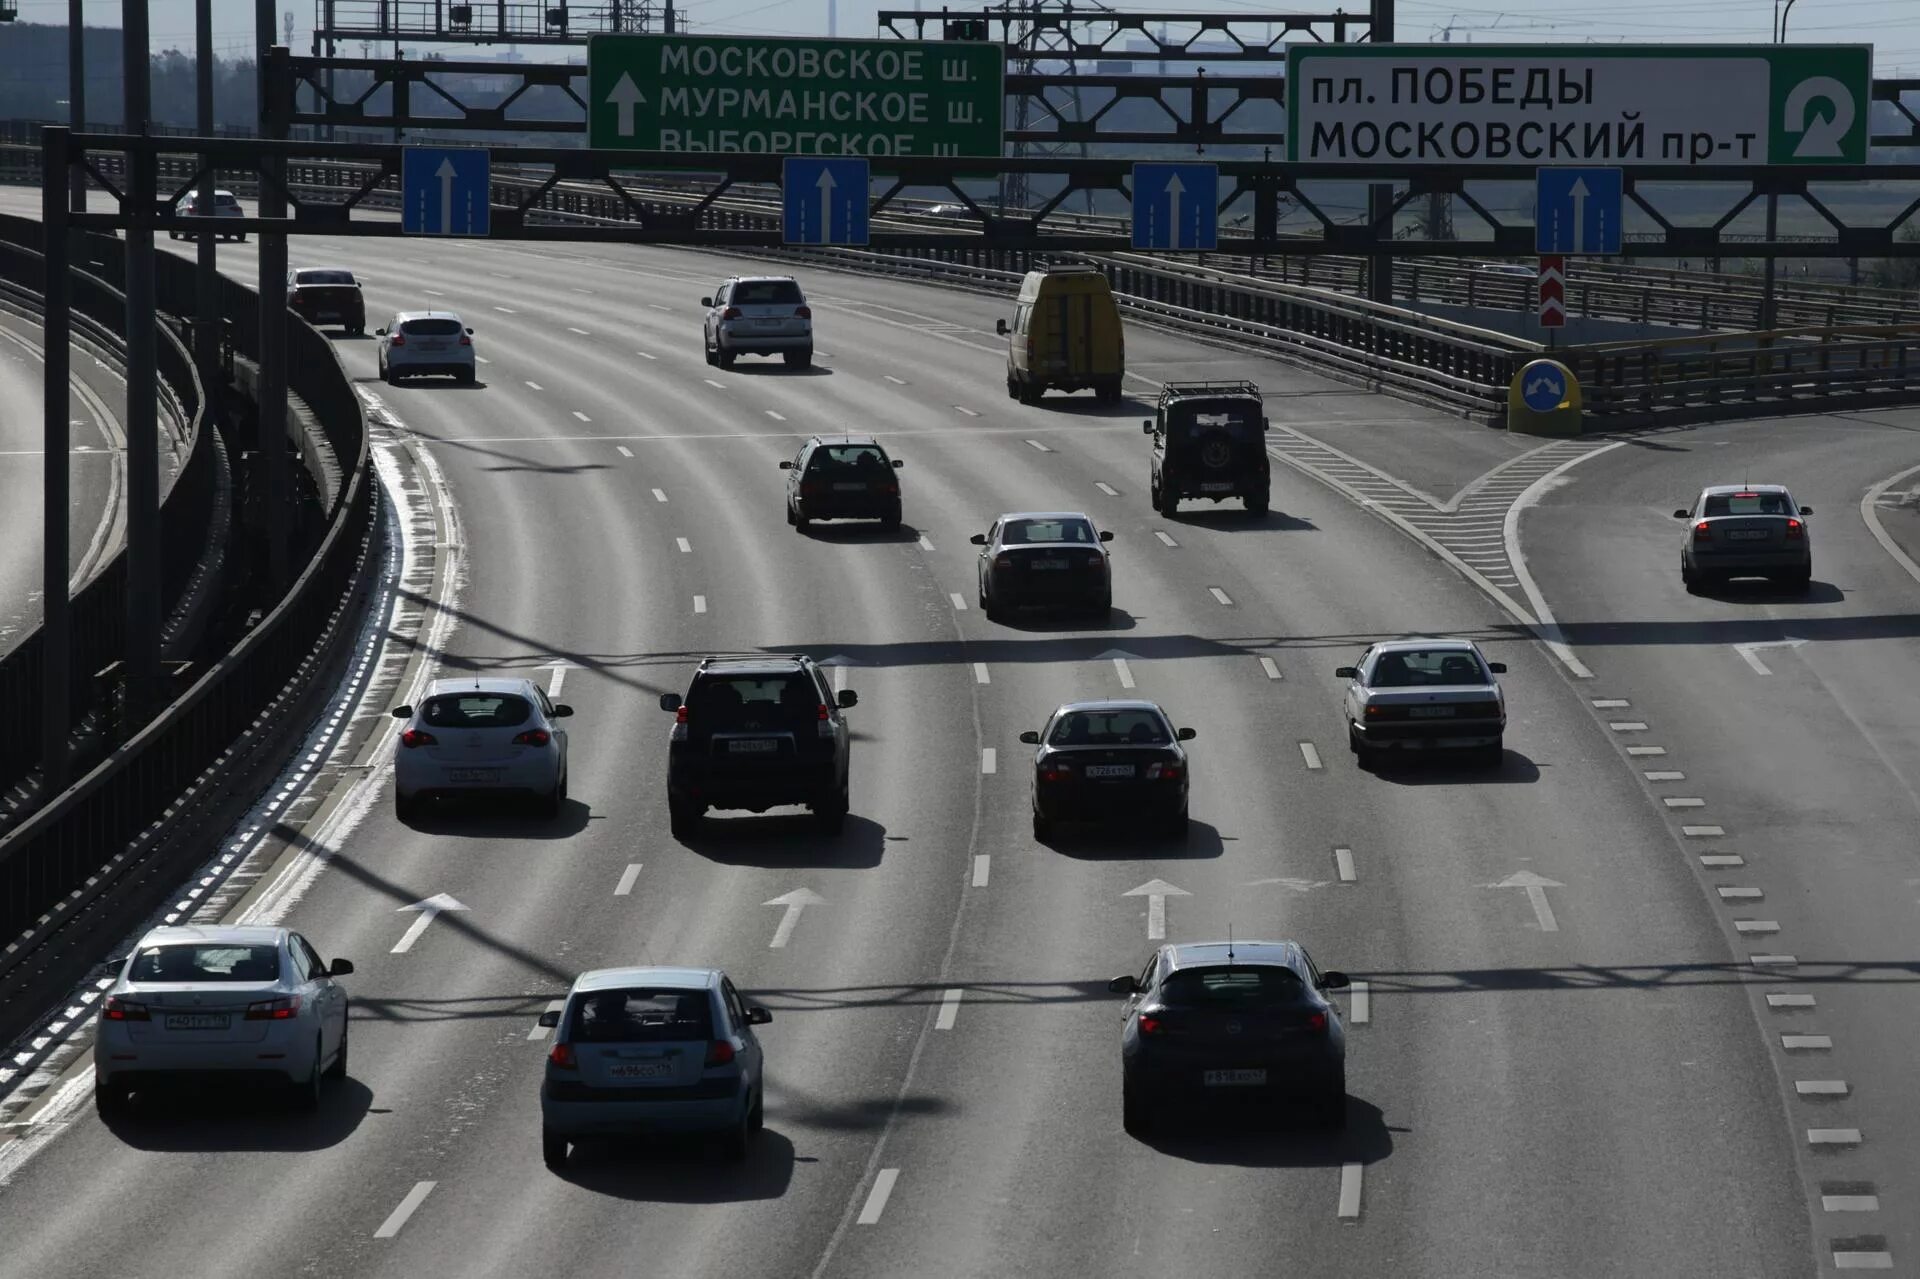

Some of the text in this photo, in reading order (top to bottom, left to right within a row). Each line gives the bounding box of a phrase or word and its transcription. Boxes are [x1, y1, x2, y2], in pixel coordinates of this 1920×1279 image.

[659, 44, 978, 82] МОСКОВСКОЕ ш.
[659, 87, 984, 125] МУРМАНСКОЕ ш.
[1312, 67, 1593, 111] пл. ПОБЕДЫ
[659, 128, 915, 157] ВЫБОРГСКОЕ
[1310, 110, 1756, 165] МОСКОВСКИЙ пр-т
